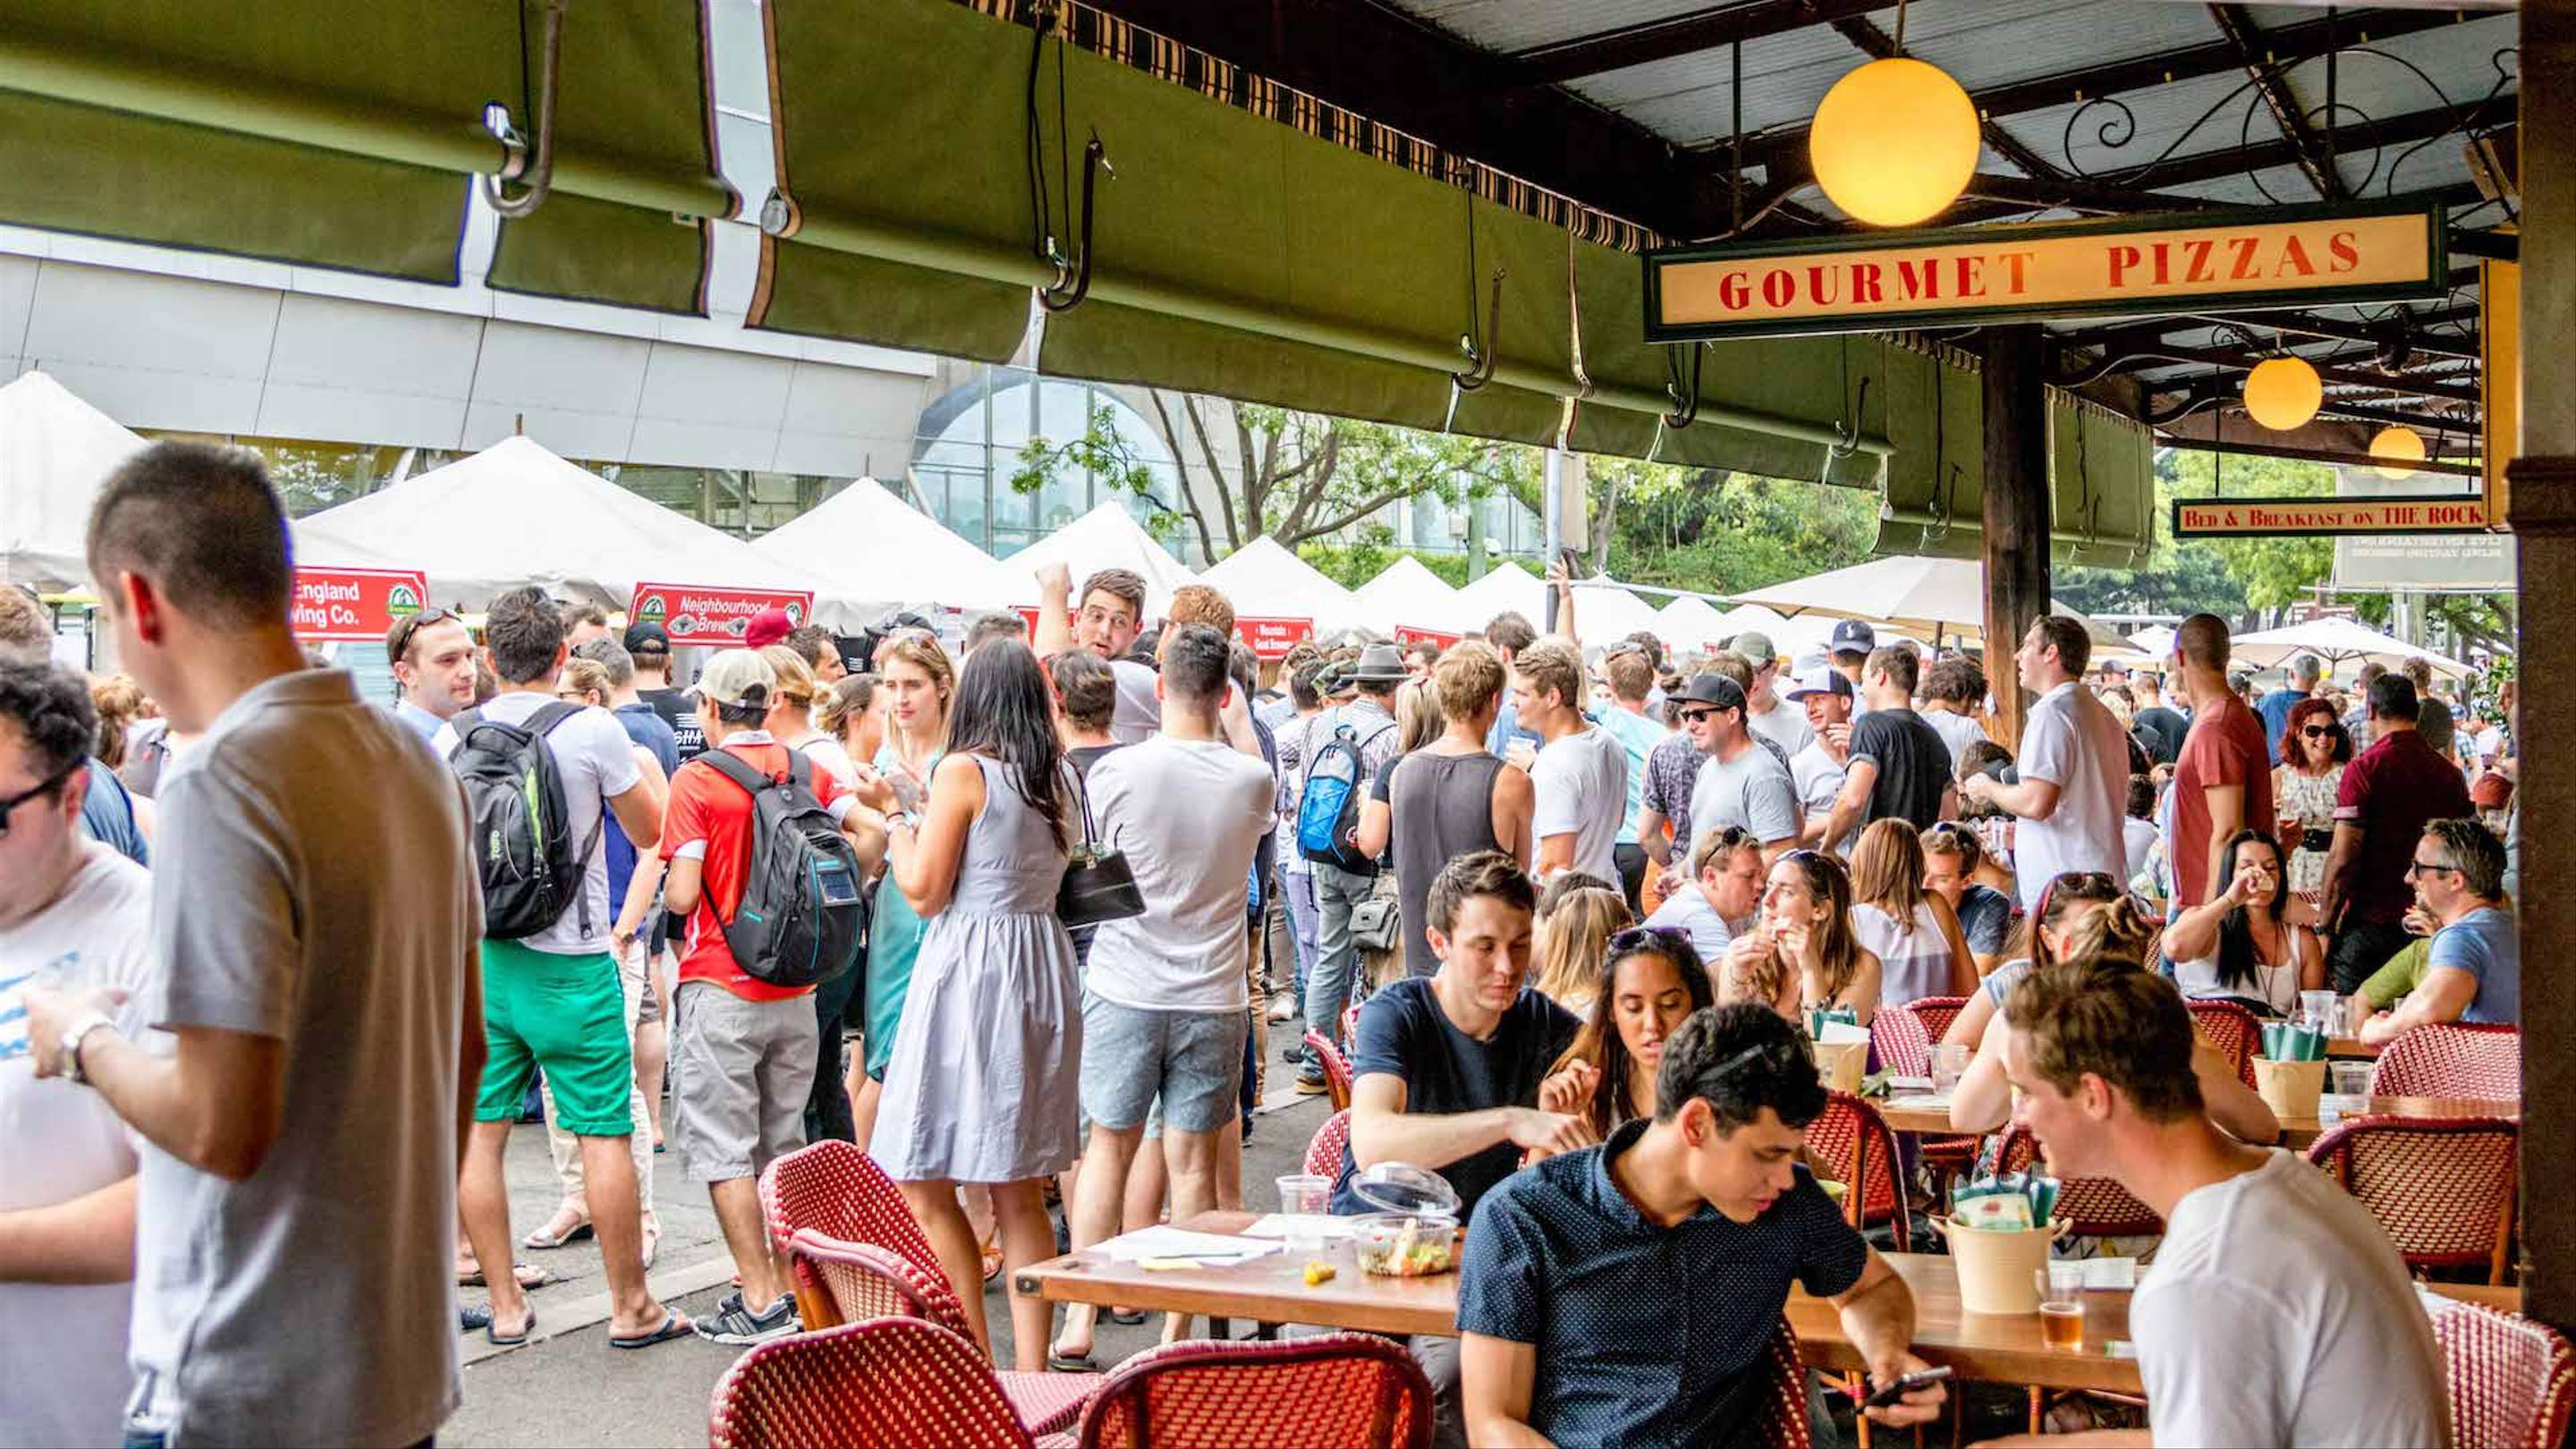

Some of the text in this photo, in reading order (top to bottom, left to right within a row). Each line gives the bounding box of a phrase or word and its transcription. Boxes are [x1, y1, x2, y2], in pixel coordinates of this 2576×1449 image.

[1718, 230, 2360, 311] GOURMET PIZZAS
[2224, 512, 2240, 527] &
[2382, 507, 2420, 526] THE
[330, 605, 360, 624] Co.
[679, 596, 772, 615] Neighbourhood
